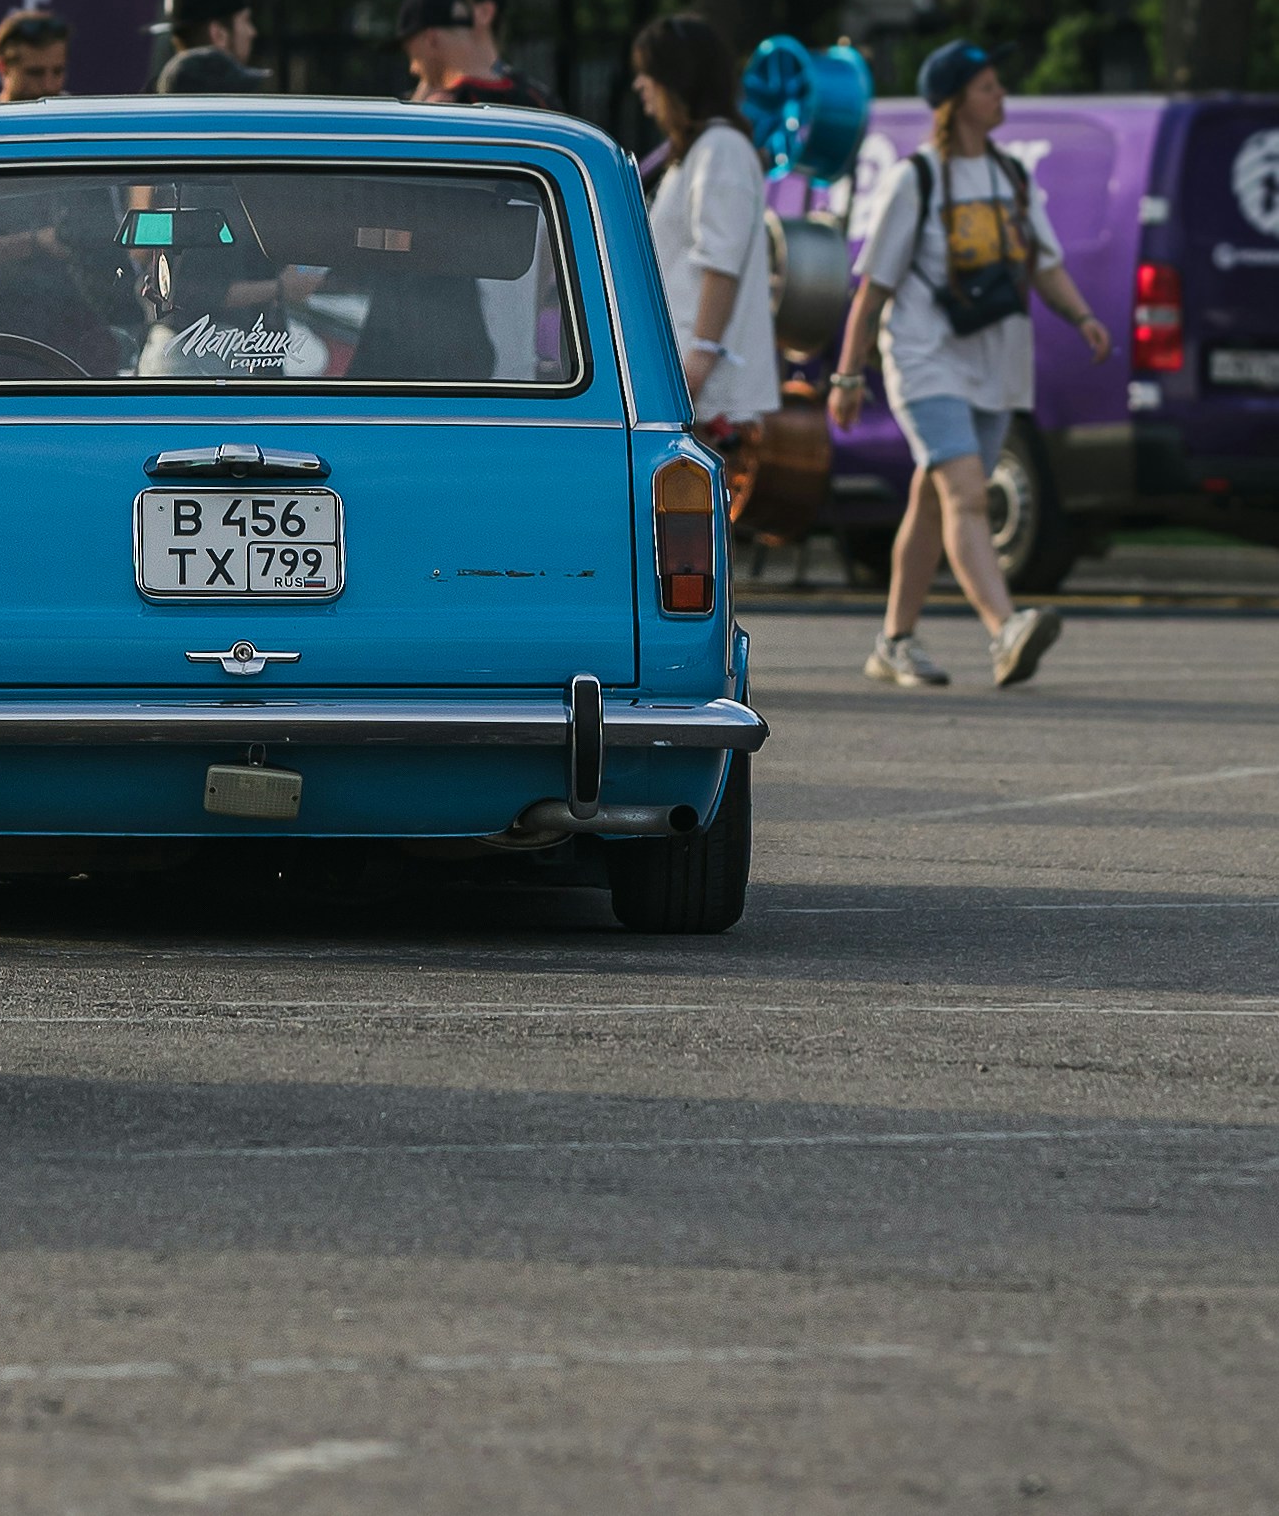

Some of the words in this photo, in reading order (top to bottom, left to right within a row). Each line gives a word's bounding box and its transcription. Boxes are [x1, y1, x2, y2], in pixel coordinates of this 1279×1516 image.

[221, 499, 307, 538] 456
[256, 547, 323, 577] 799
[274, 577, 303, 588] RUS
